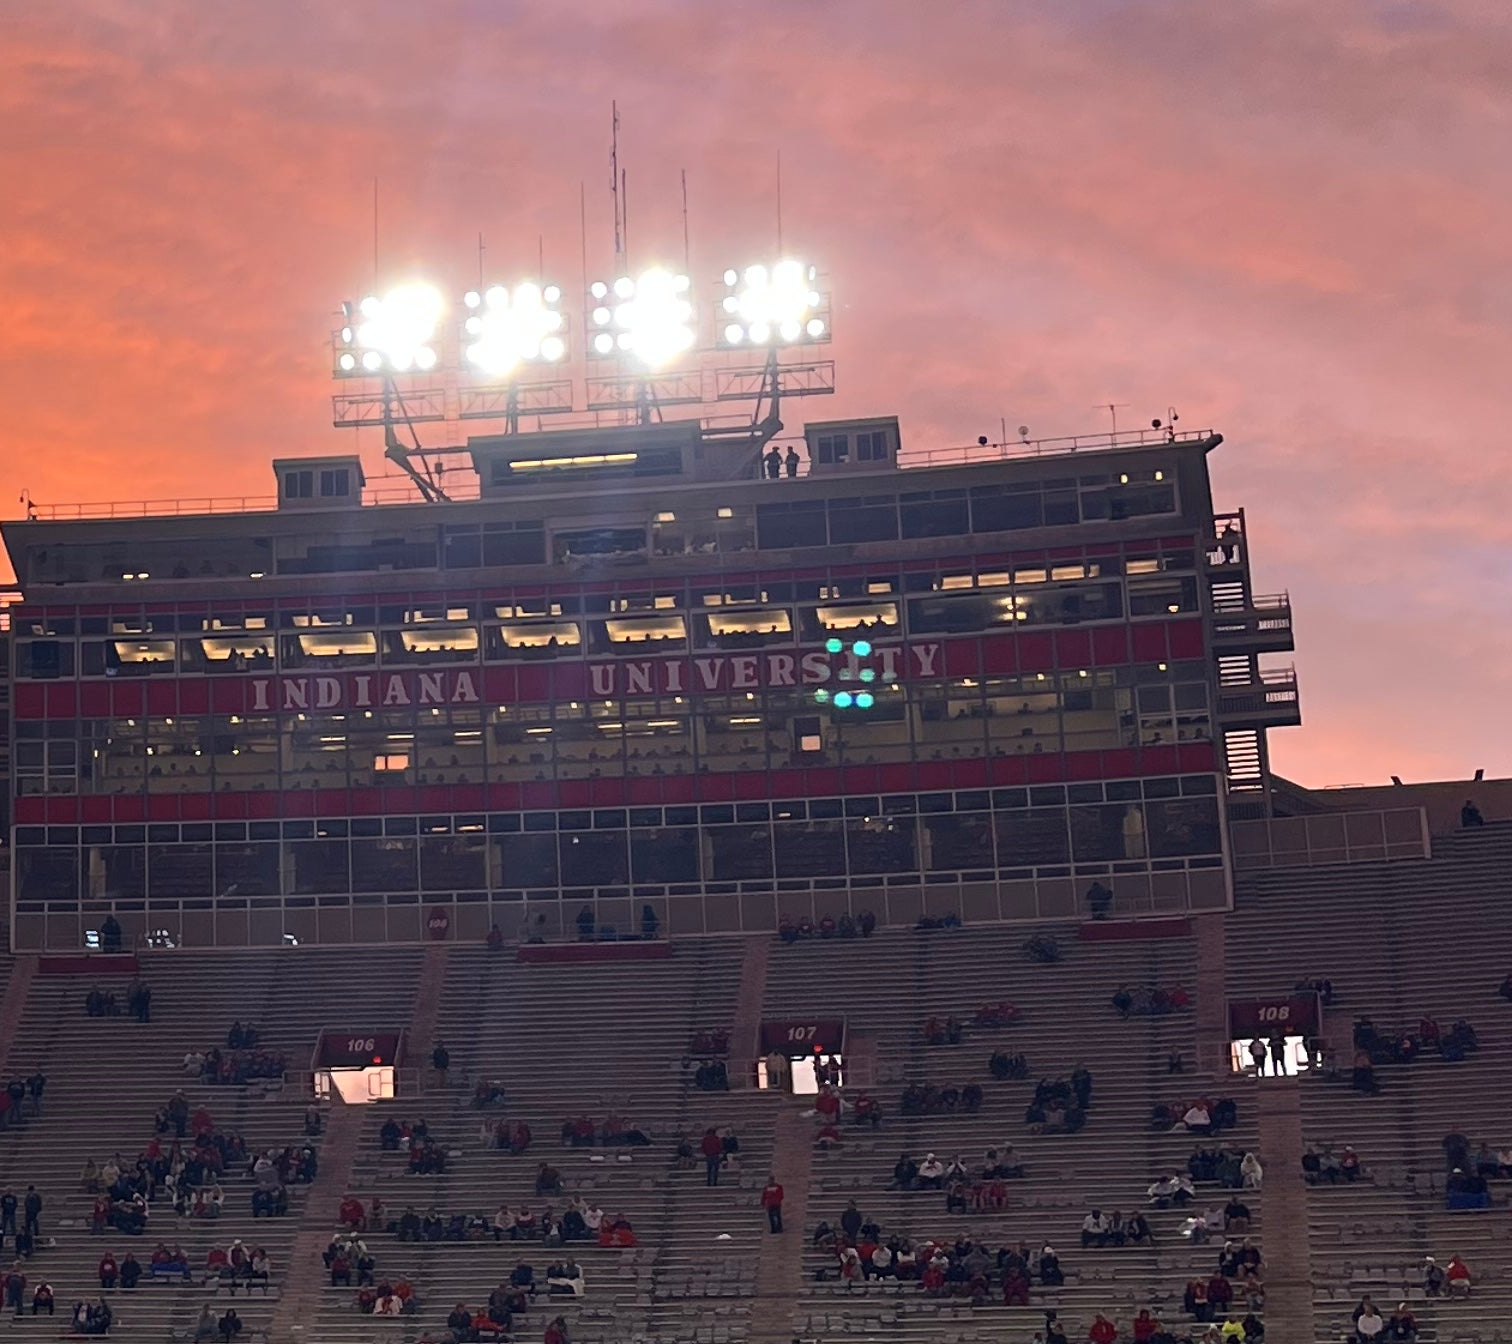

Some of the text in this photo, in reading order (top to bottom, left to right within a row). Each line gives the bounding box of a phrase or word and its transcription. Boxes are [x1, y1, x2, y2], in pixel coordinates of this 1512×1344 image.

[252, 644, 939, 710] INDIANA UNIVERSITY
[1258, 1005, 1290, 1022] 108
[788, 1026, 817, 1041] 107
[348, 1038, 376, 1052] 106
